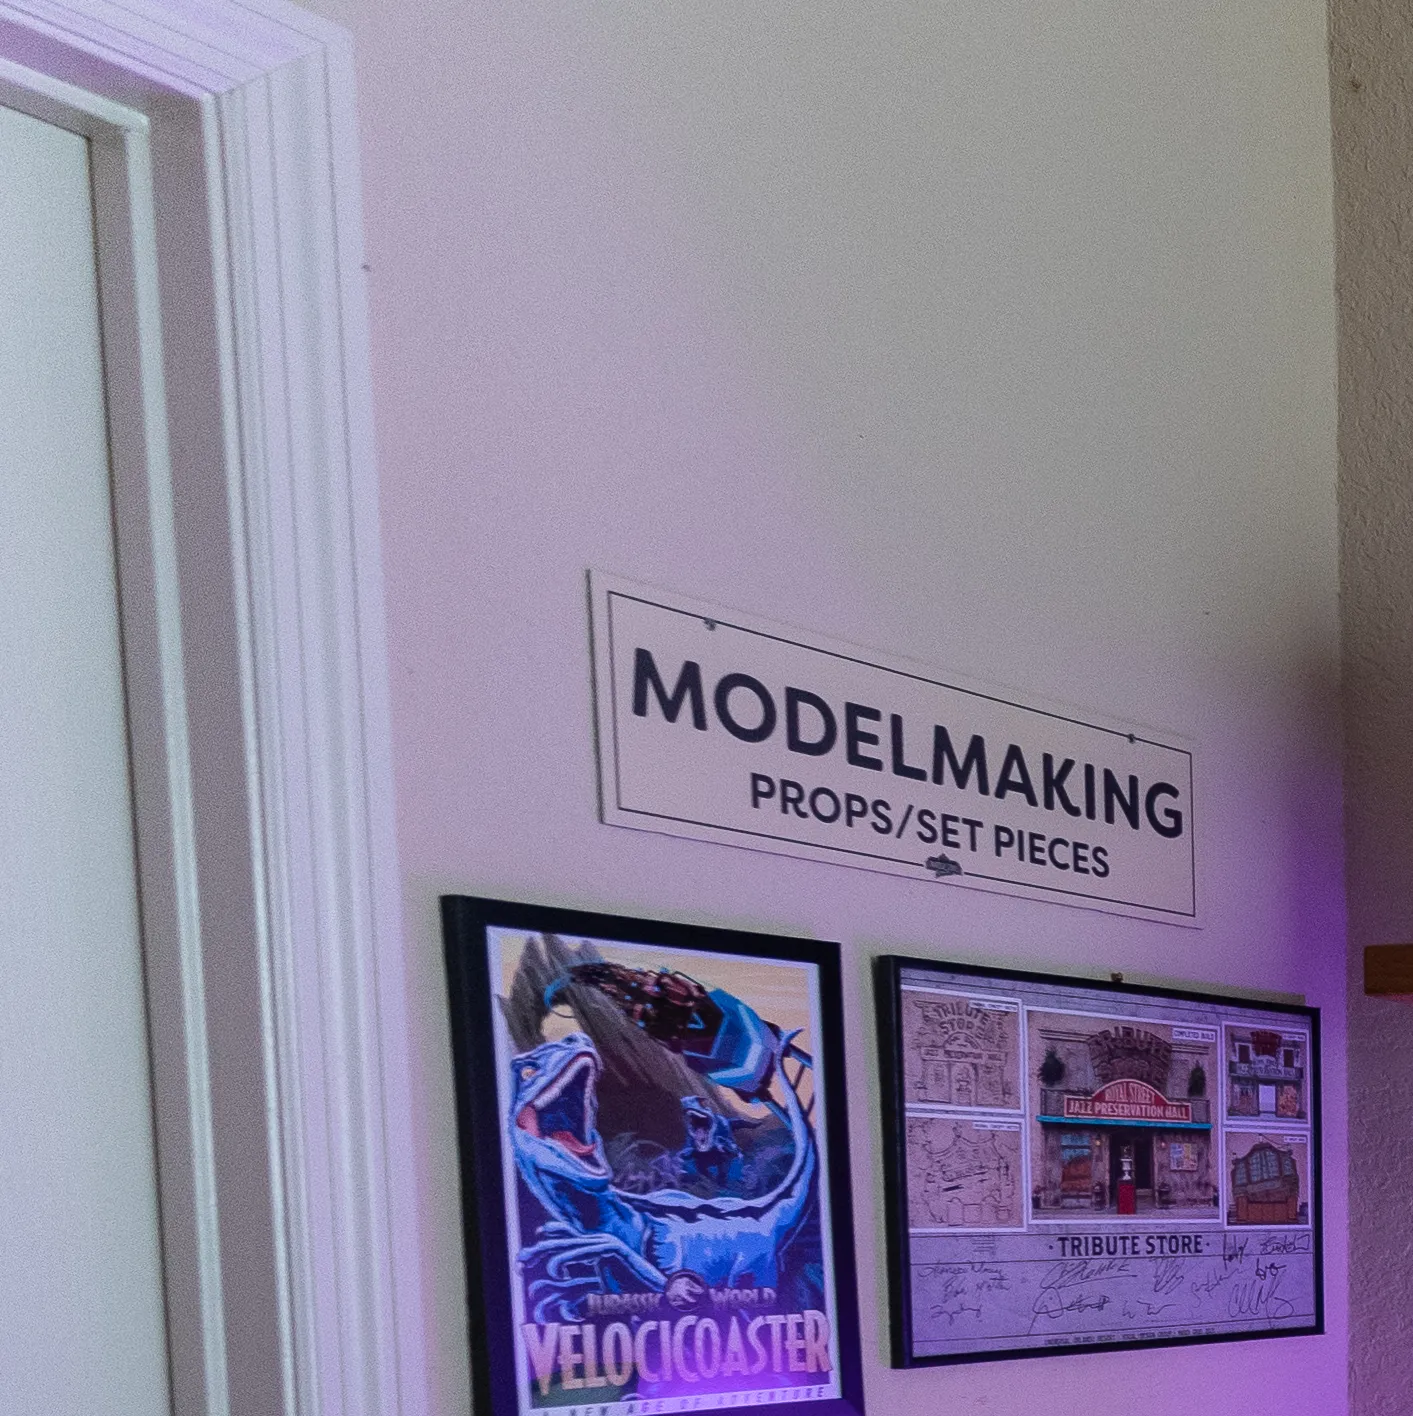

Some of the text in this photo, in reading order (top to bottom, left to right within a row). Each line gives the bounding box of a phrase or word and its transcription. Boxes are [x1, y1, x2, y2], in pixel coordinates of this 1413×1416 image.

[631, 647, 1184, 839] MODELMAKING
[749, 772, 1111, 878] PROPS/SET PIECES
[1128, 1082, 1155, 1104] STREET
[1068, 1100, 1188, 1119] JAZZ PRESERVATION HALL
[1057, 1234, 1203, 1257] TRIBUTE STORE
[586, 1287, 778, 1316] JURASSIC WORLD
[521, 1309, 833, 1396] VELOCICOASTER
[626, 1400, 664, 1415] AGE
[716, 1386, 826, 1406] ADVENTURE
